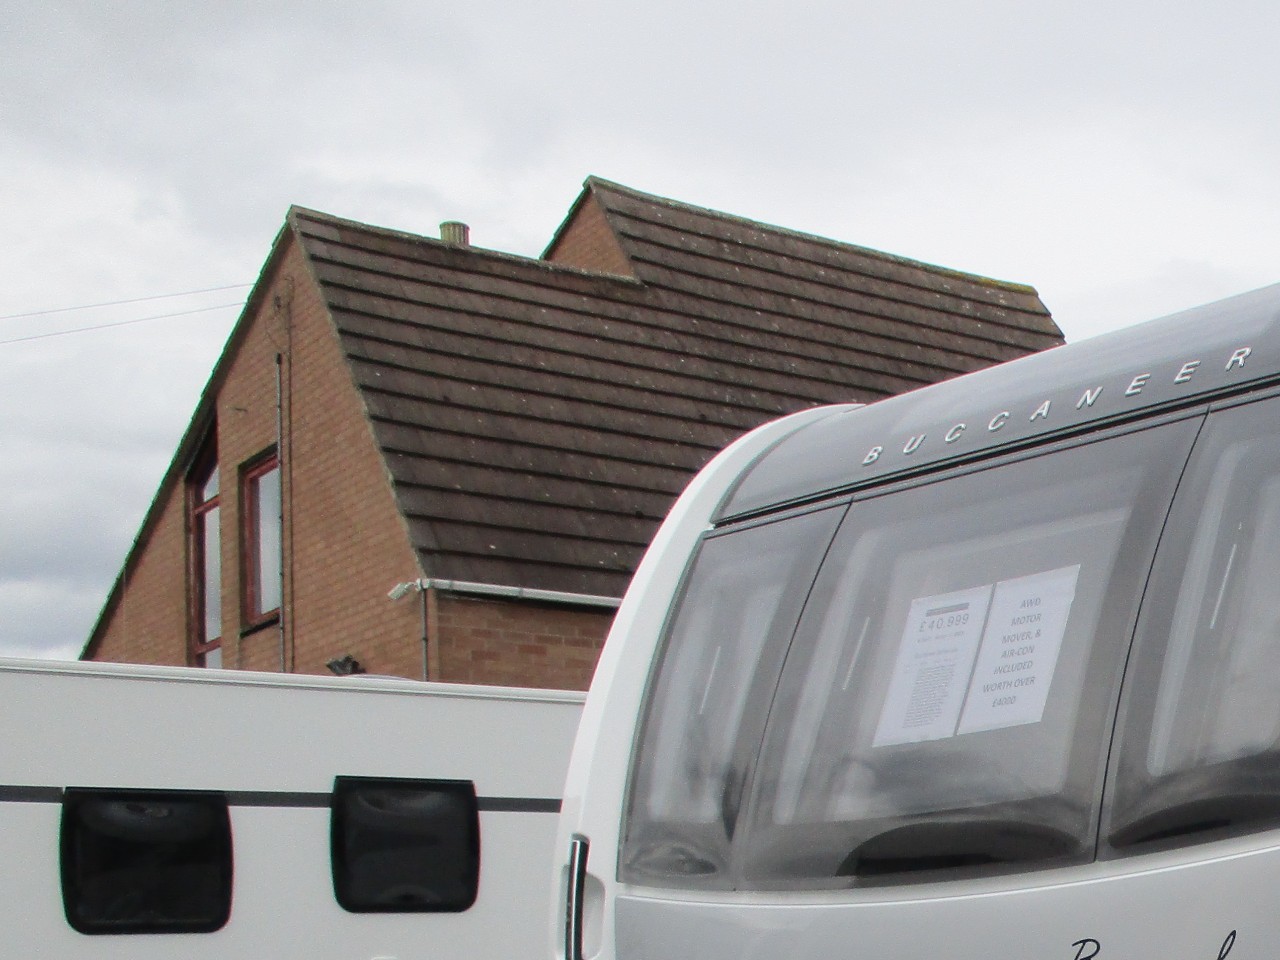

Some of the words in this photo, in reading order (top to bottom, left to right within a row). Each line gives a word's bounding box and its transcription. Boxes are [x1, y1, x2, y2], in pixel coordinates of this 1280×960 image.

[862, 346, 1252, 466] BUCCANEER
[1011, 614, 1042, 627] MOTOR
[1001, 645, 1035, 659] AIR-CON
[993, 661, 1034, 675] INCLUDED
[983, 680, 1013, 693] WORTH
[1013, 676, 1036, 688] OVER
